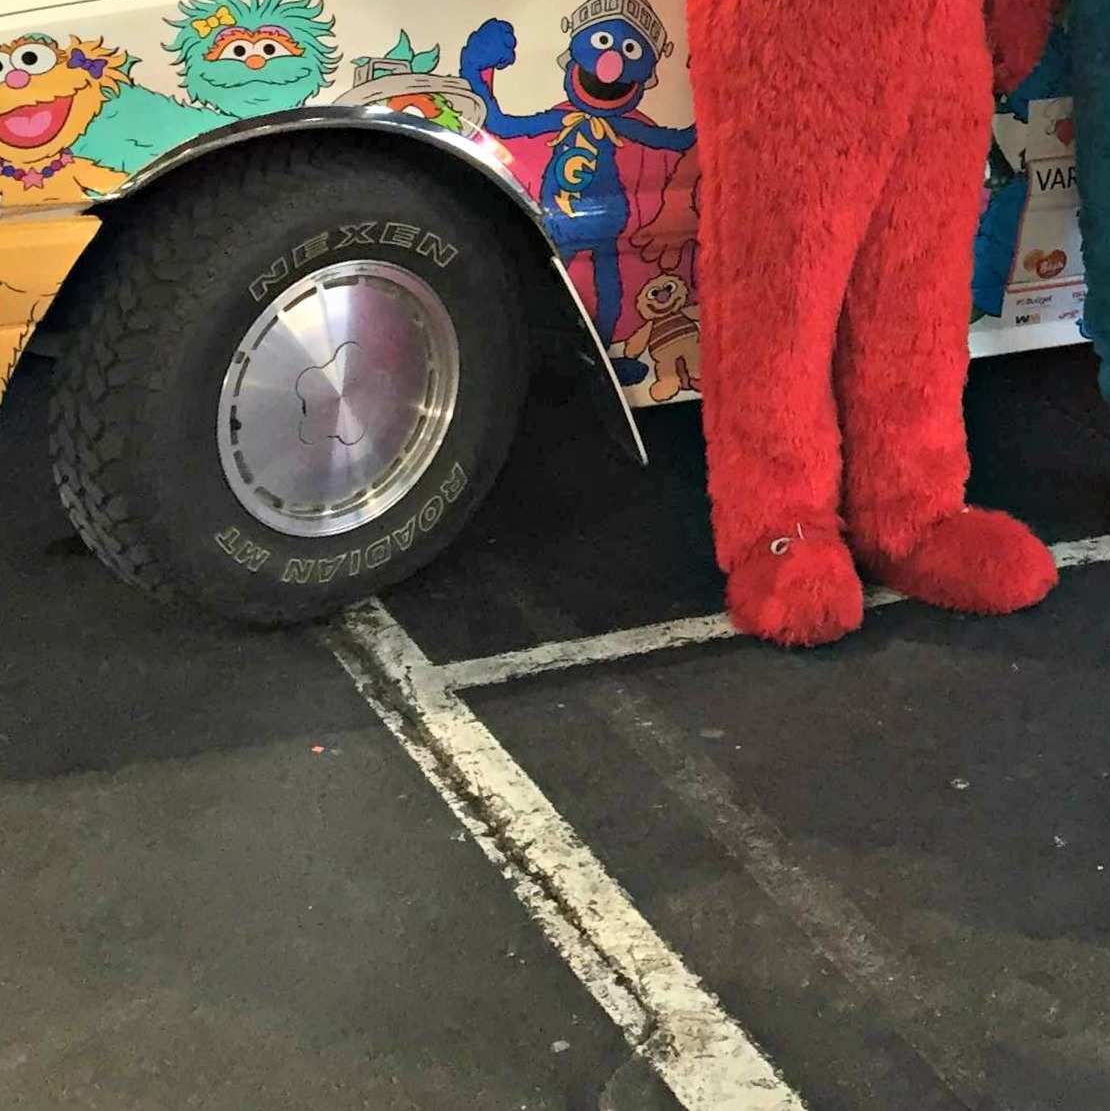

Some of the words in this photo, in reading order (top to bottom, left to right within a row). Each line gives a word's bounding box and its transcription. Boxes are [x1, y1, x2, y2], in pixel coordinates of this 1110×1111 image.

[249, 221, 459, 301] NEXEN
[214, 526, 271, 572] MT
[281, 462, 469, 584] ROADIAN
